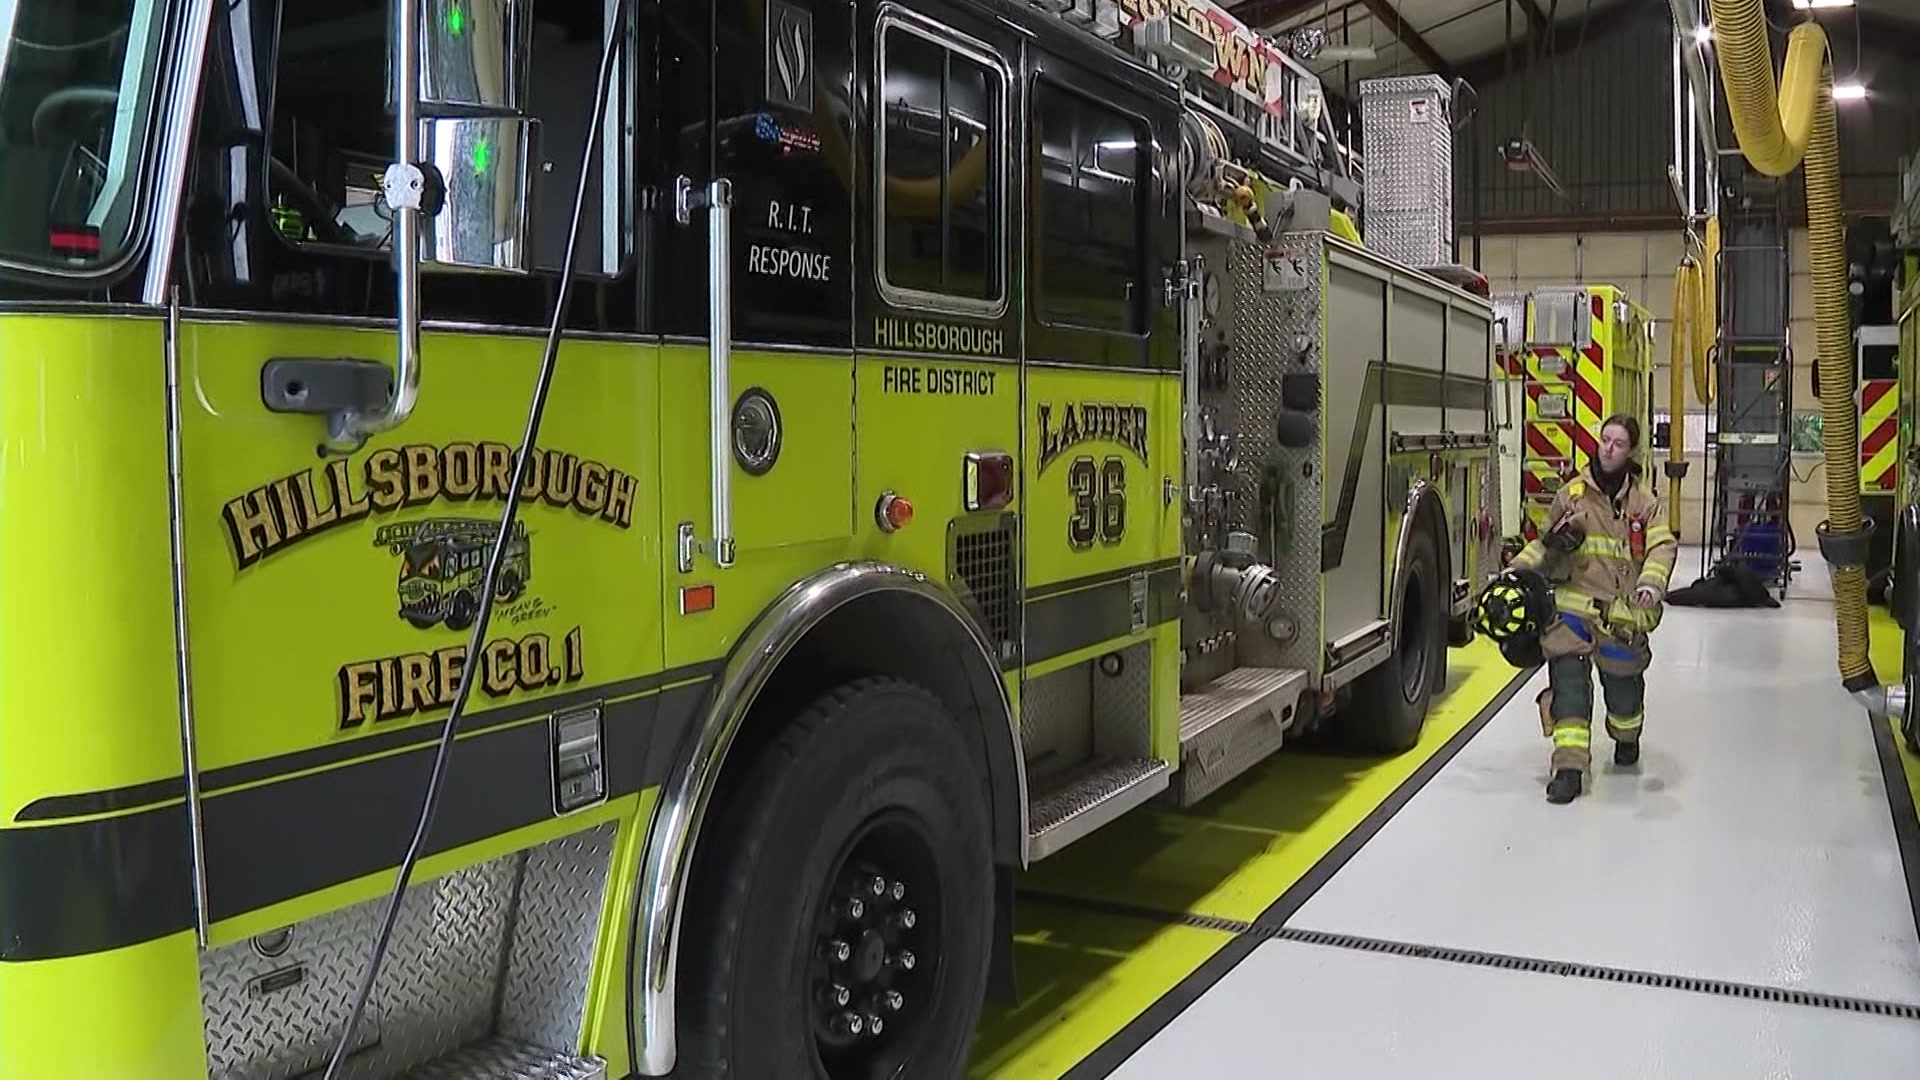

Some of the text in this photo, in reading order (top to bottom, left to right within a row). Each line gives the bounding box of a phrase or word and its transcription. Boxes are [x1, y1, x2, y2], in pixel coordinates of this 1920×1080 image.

[768, 200, 812, 234] R.I.T.
[749, 245, 831, 281] RESPONSE
[874, 317, 1004, 354] HILLSBOROUGH
[884, 366, 996, 396] FIRE DISTRICT
[1037, 401, 1150, 480] LADDER
[222, 441, 640, 571] HILLSBOROUGH
[1068, 456, 1127, 549] 36
[338, 645, 469, 729] FIRE
